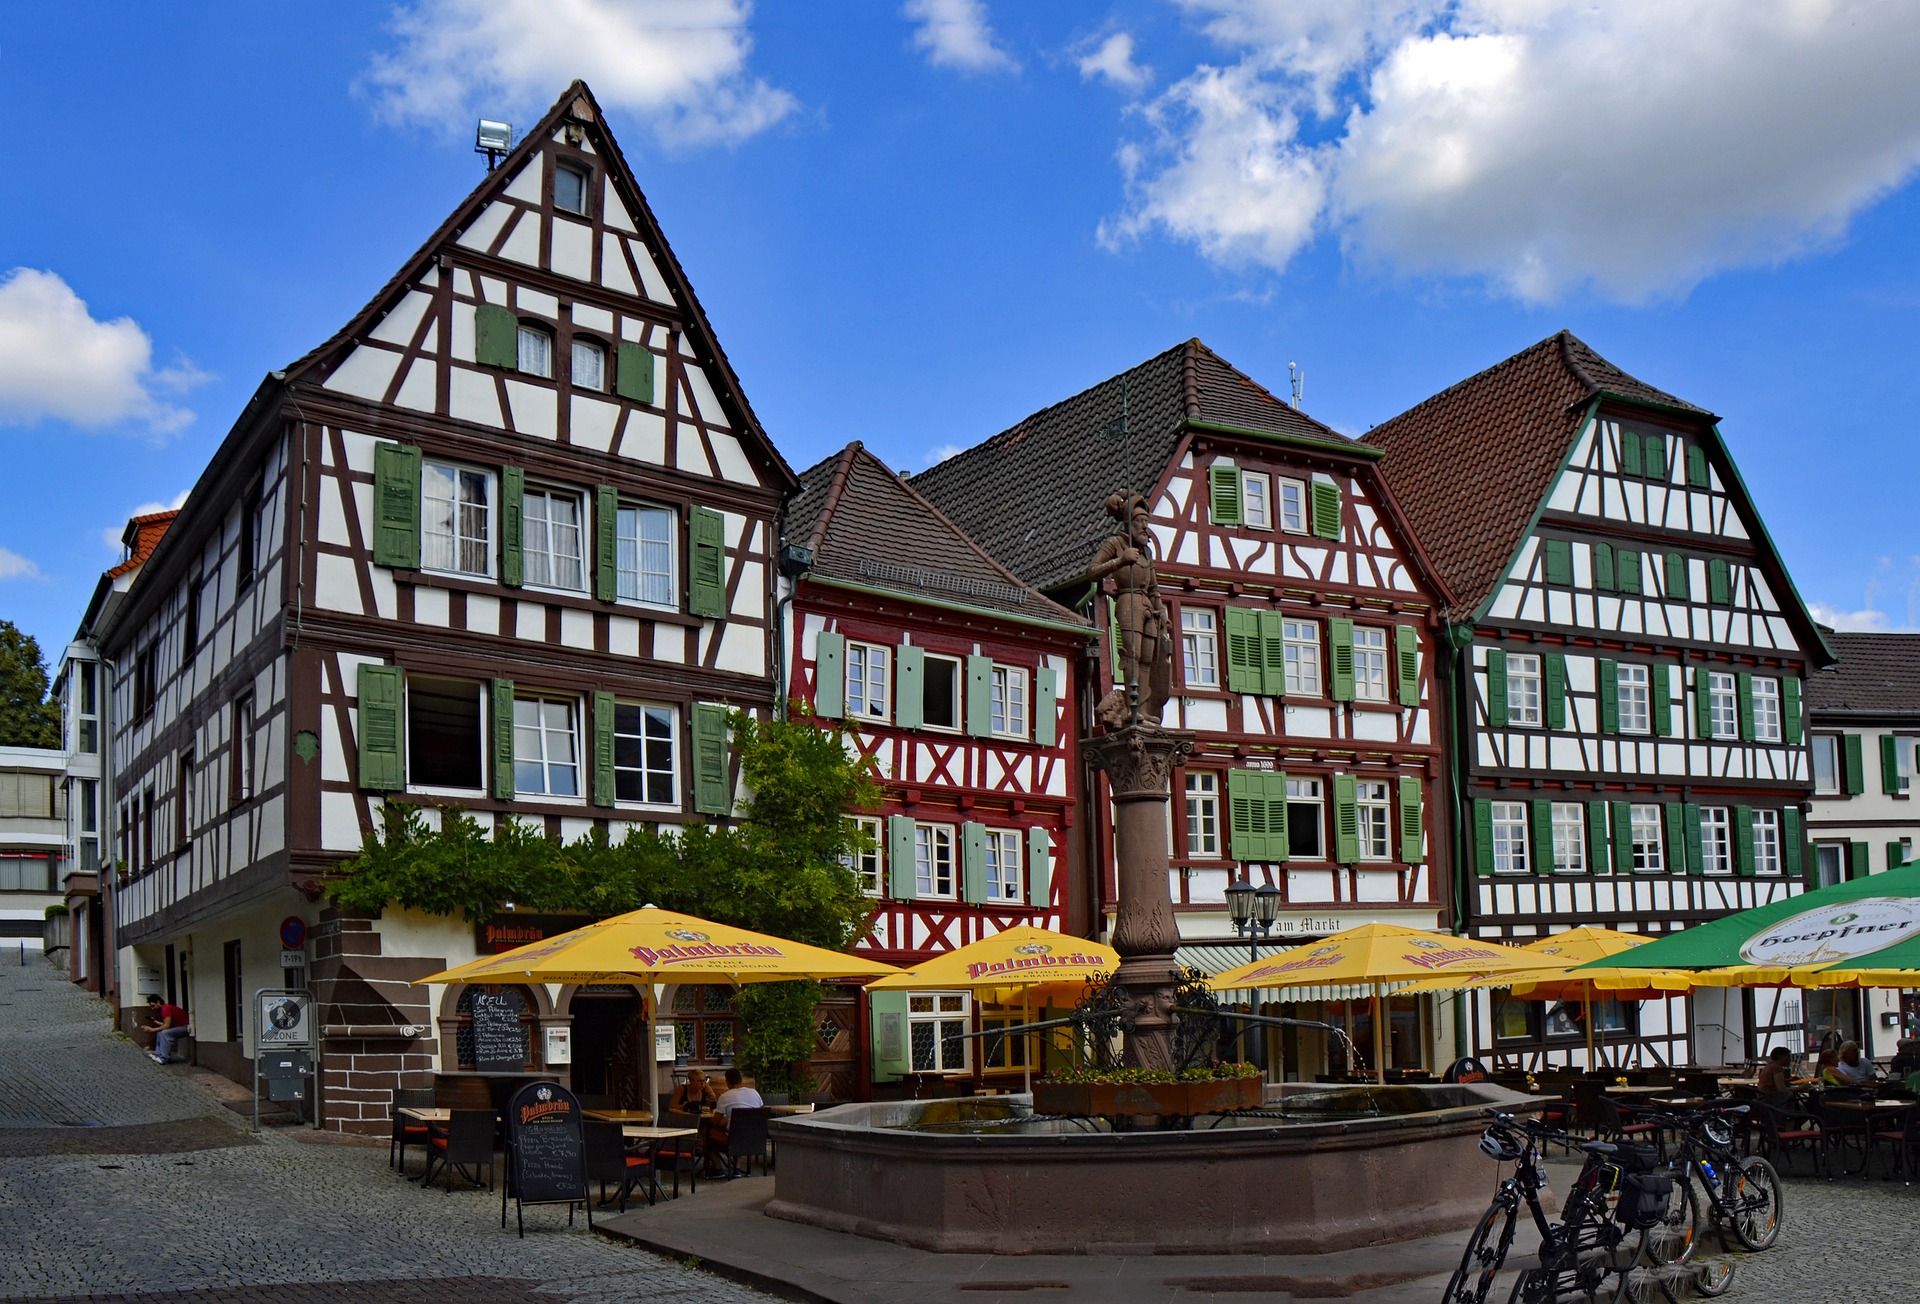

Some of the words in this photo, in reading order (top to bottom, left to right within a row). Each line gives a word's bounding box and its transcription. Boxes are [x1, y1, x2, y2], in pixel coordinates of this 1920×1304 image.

[486, 924, 543, 944] Palmbräu
[1276, 922, 1294, 932] am
[1300, 918, 1340, 932] Markt
[628, 942, 782, 967] Palmbräu
[966, 953, 1104, 980] Palmbräu
[274, 1032, 298, 1040] ZONE
[520, 1099, 570, 1125] Palmbräu
